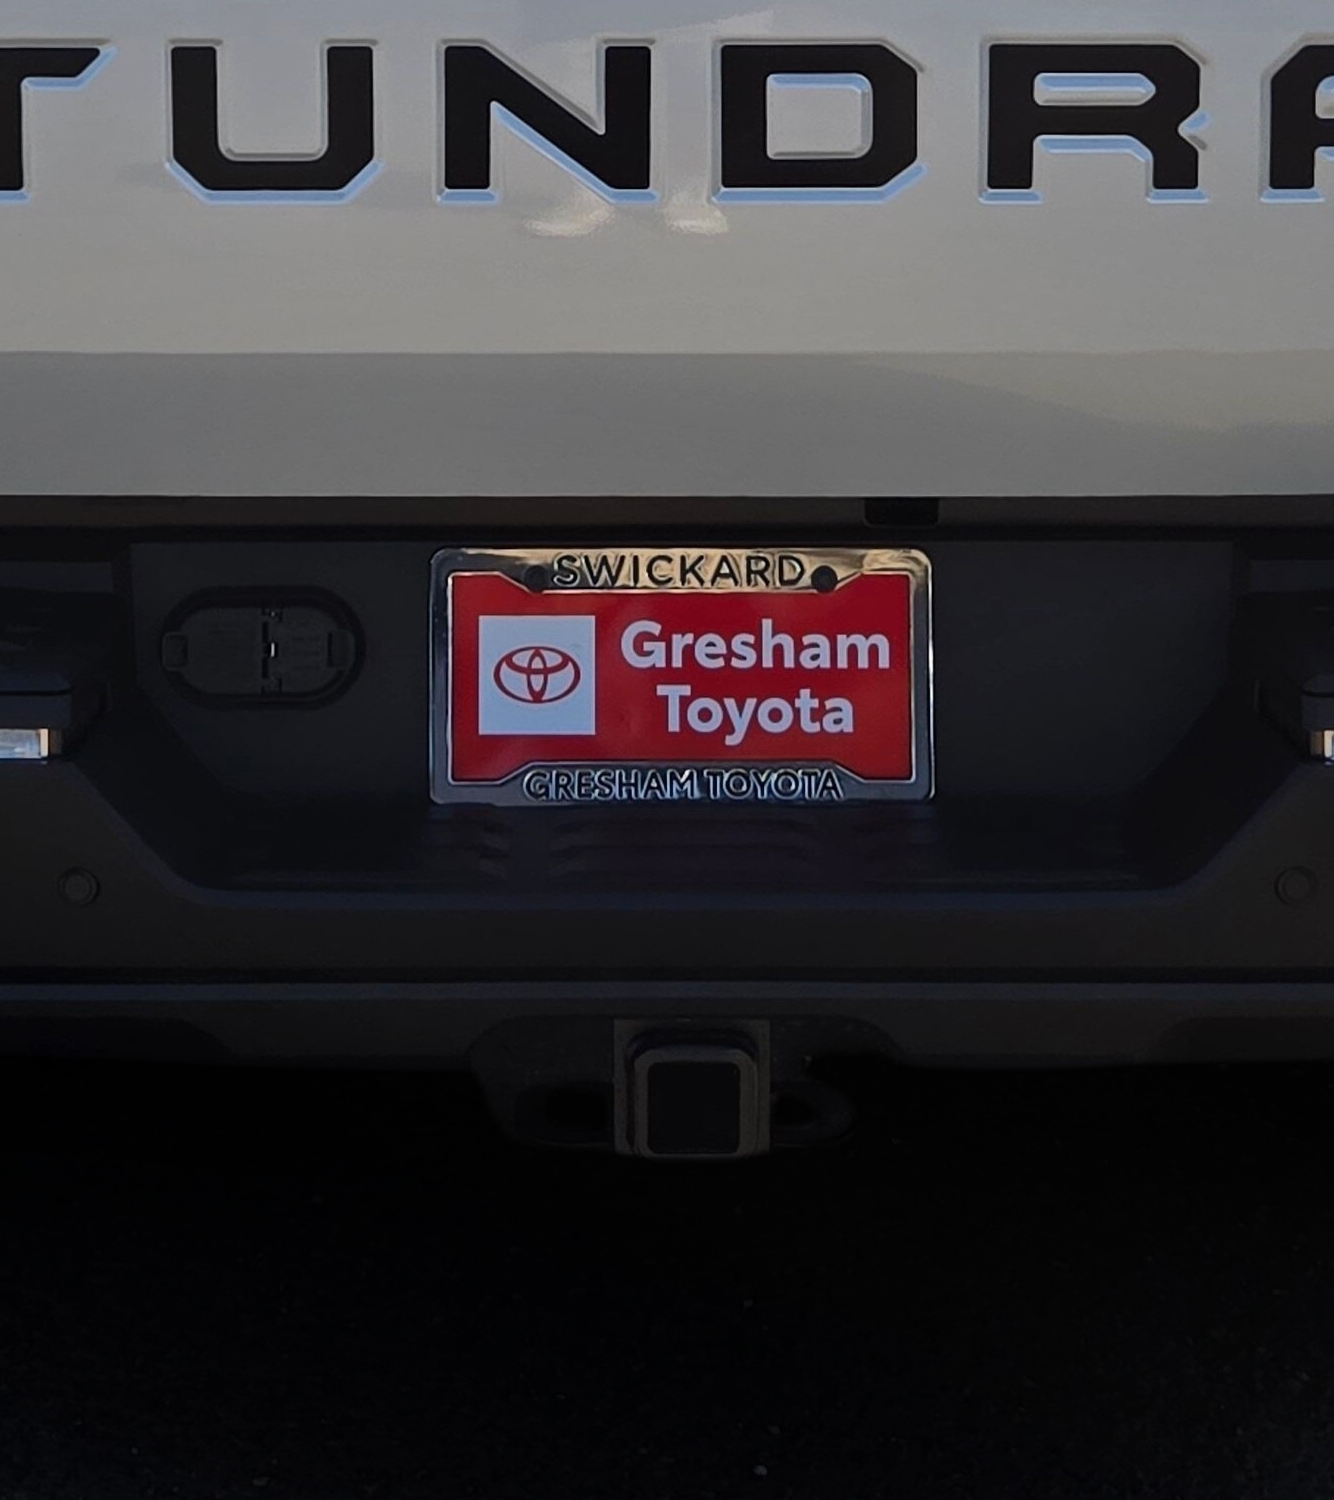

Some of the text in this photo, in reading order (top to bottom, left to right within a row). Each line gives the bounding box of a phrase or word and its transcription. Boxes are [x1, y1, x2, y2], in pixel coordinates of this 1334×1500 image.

[552, 555, 805, 587] SWICKARD
[620, 618, 890, 669] Gresham
[656, 684, 855, 746] Toyota
[523, 769, 845, 800] GRESHAM TOYOTA
